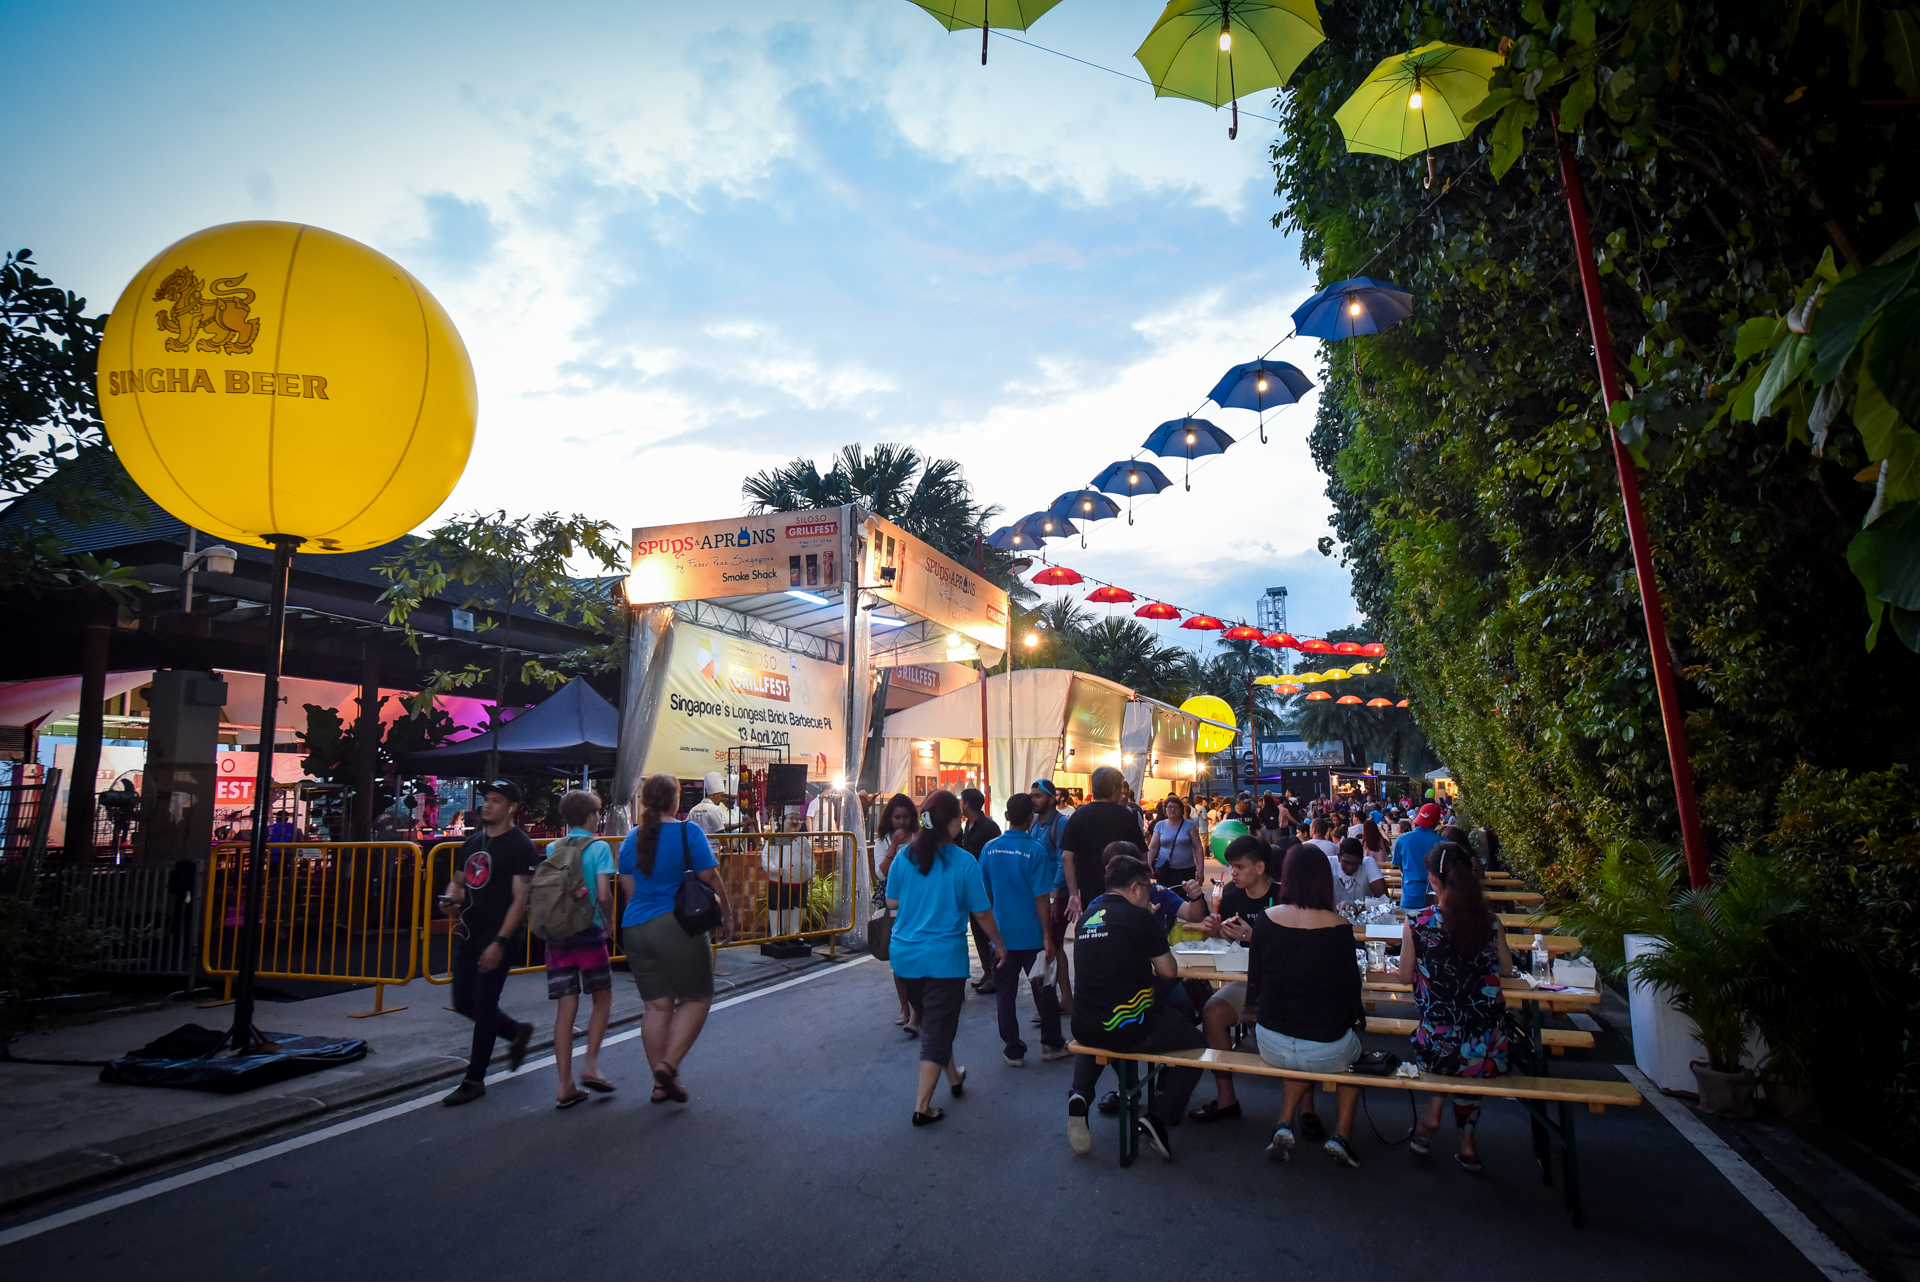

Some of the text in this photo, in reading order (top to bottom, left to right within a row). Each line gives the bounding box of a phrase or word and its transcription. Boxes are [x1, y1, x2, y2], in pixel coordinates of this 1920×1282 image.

[109, 367, 330, 400] SINGHA BEER
[795, 514, 827, 524] SILOSO
[788, 524, 835, 536] GRILLFEST
[638, 536, 694, 559] SPUDS
[675, 563, 685, 574] by
[731, 554, 775, 568] Singapore
[722, 568, 778, 582] Smoke Shack
[732, 670, 787, 697] GRILLFEST
[895, 665, 937, 688] GRILLFEST
[670, 693, 730, 718] Singapore's
[732, 703, 767, 725] Longest
[768, 709, 788, 725] Brick
[789, 712, 823, 730] Barbecue
[738, 727, 748, 742] 13
[771, 730, 789, 746] 2017
